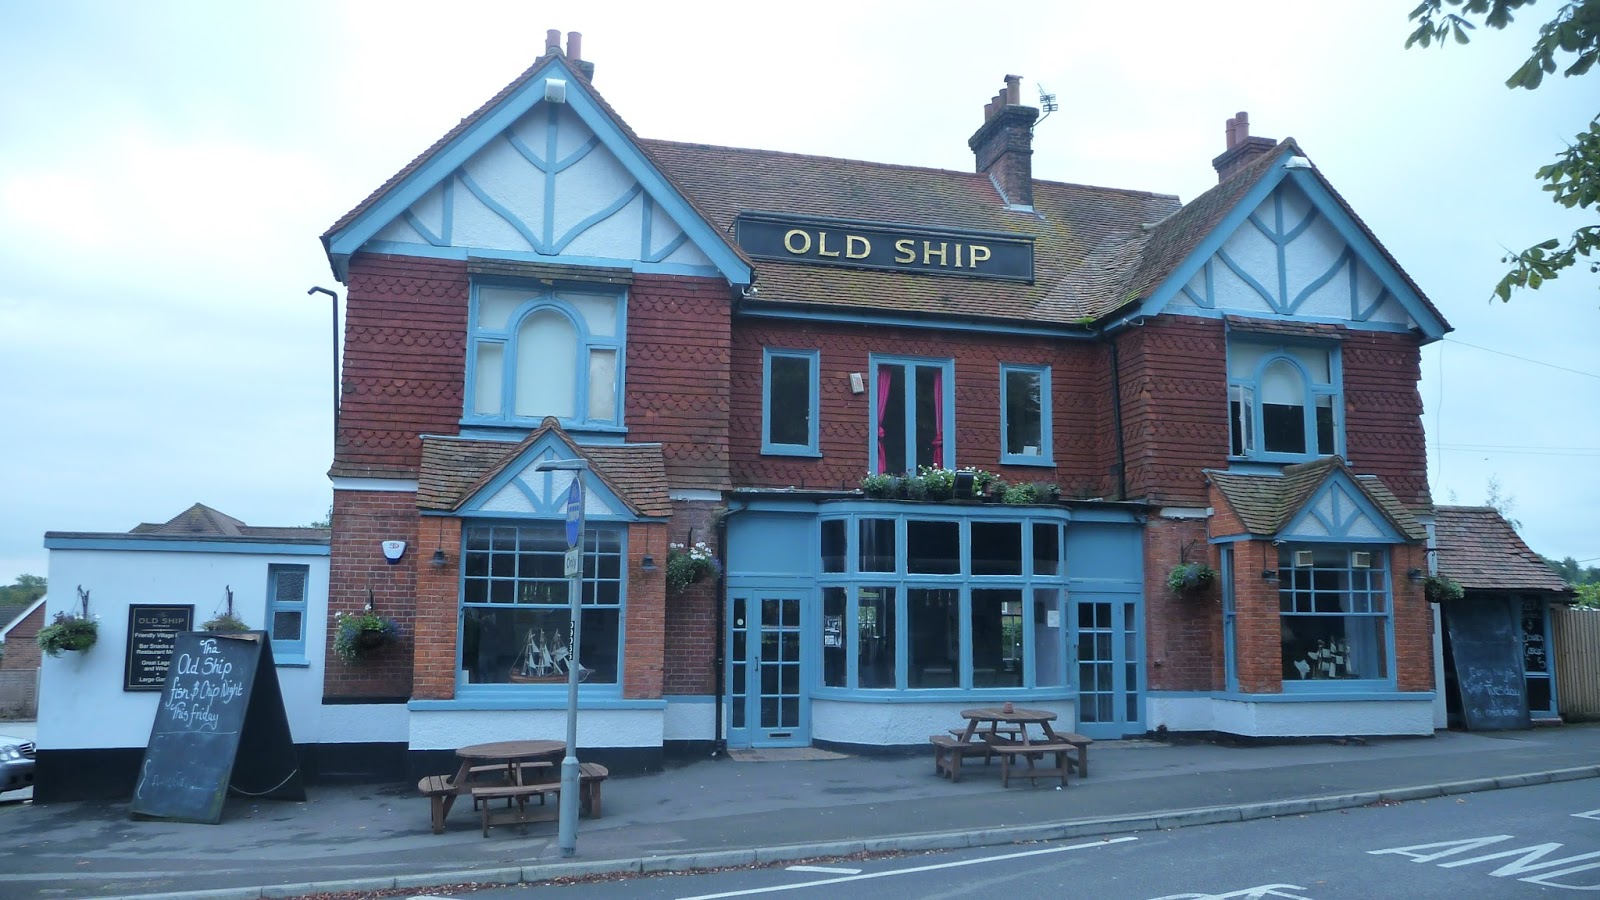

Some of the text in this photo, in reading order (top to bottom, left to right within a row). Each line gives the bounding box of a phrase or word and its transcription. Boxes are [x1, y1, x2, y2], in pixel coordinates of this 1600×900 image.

[784, 229, 992, 269] OLD SHIP
[567, 556, 577, 570] Only
[162, 617, 185, 625] SHIP
[178, 653, 233, 680] Old Ship
[199, 680, 220, 706] Chip
[220, 679, 243, 704] Night
[170, 701, 189, 722] This
